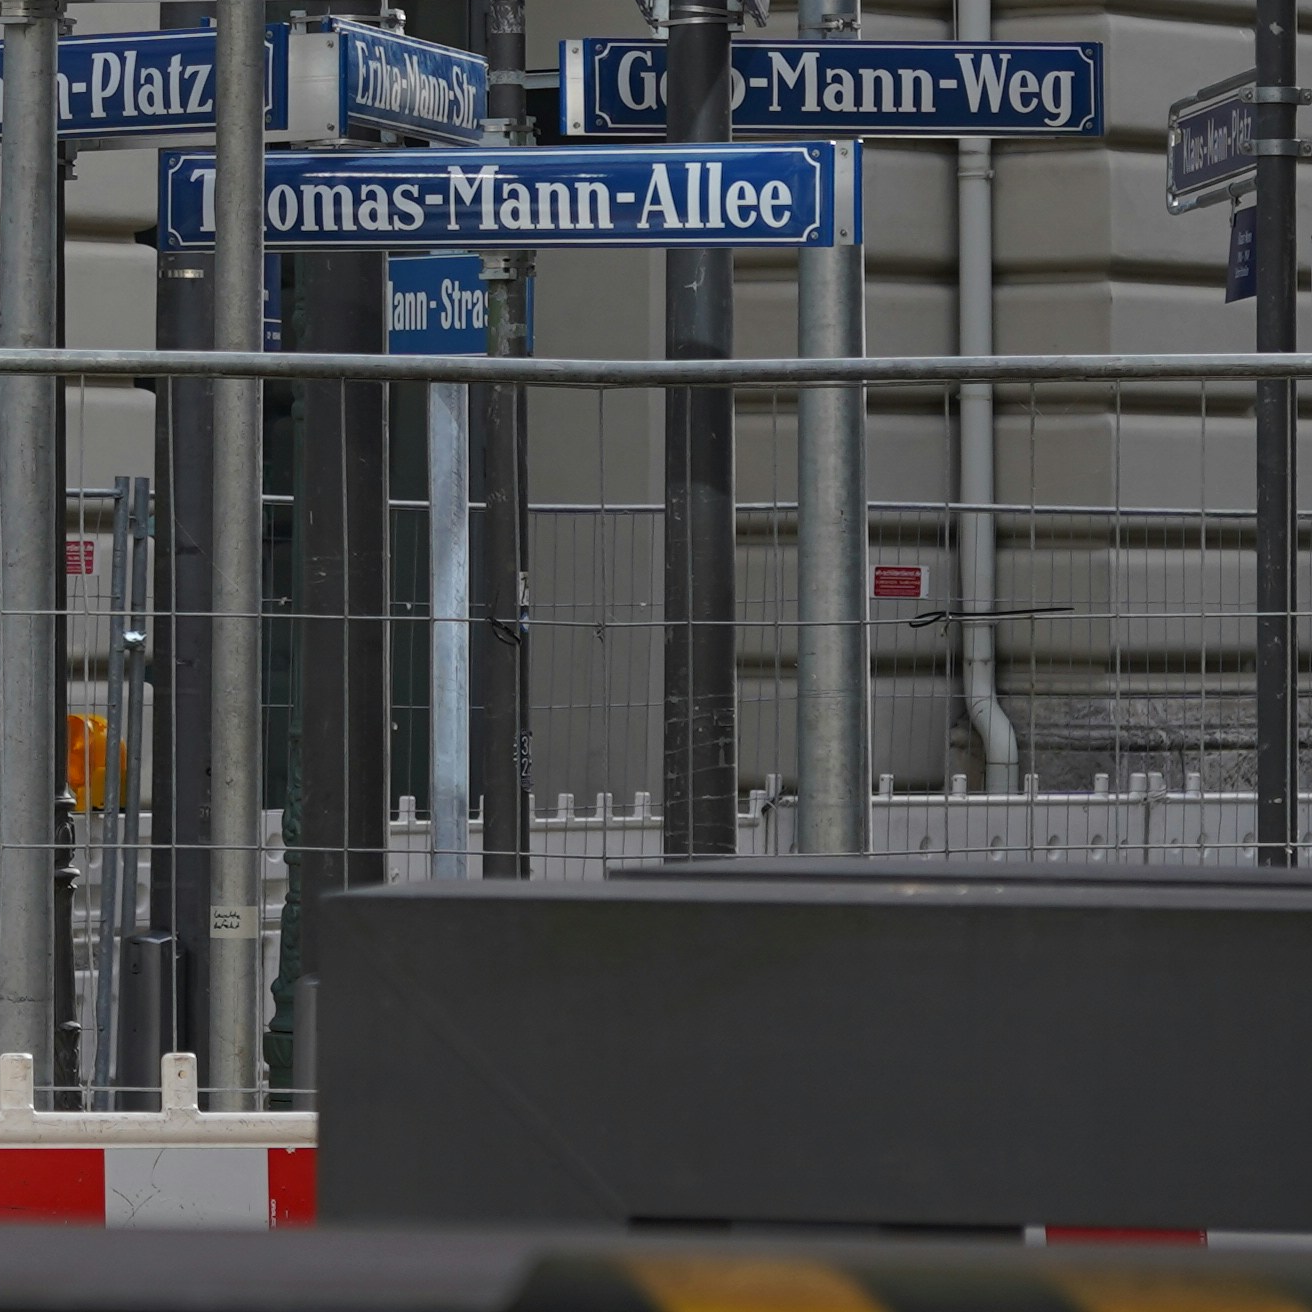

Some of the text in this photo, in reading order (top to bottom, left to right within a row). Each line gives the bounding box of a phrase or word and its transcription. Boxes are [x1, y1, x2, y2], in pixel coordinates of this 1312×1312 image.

[355, 40, 478, 129] Erika-Mann-Str.
[1182, 108, 1252, 175] Klaus-Mann-Platz
[190, 162, 792, 232] Tomas-Mann-Allee
[388, 277, 489, 331] ann-Stra
